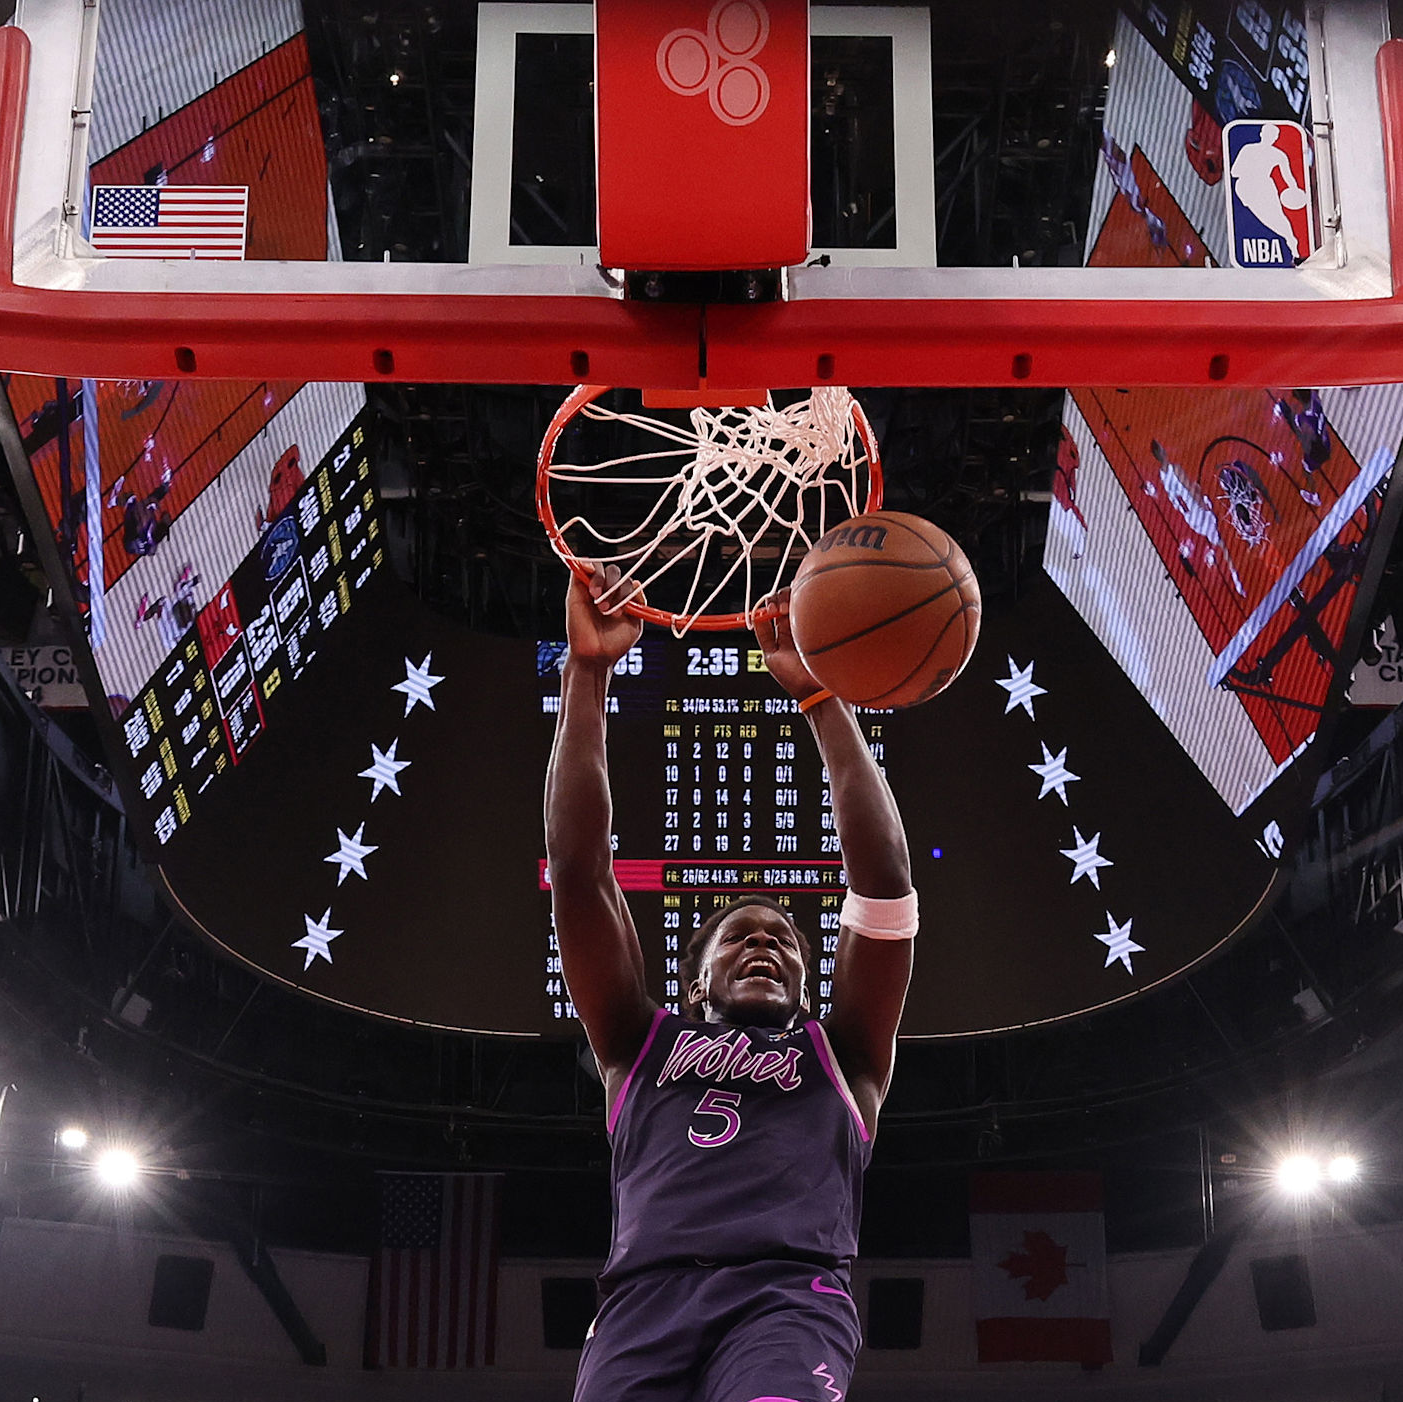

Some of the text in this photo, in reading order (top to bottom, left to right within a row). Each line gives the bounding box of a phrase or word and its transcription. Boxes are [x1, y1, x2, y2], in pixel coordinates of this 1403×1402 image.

[1243, 238, 1282, 264] NBA
[277, 577, 304, 623] 85
[246, 605, 280, 671] 2:35
[687, 648, 739, 676] 2:35
[683, 699, 711, 713] 34/64
[712, 699, 739, 713] 53.1%
[764, 699, 788, 713] 9/24
[713, 725, 732, 738] PTS
[666, 743, 795, 759] 11 12 5/8
[665, 789, 798, 806] 17 14 6/11
[664, 835, 798, 852] 27 19 7/11
[682, 869, 820, 884] 26/62 41.9% 9/25 36.0%
[656, 1029, 804, 1092] Wolves
[688, 1088, 742, 1148] 5
